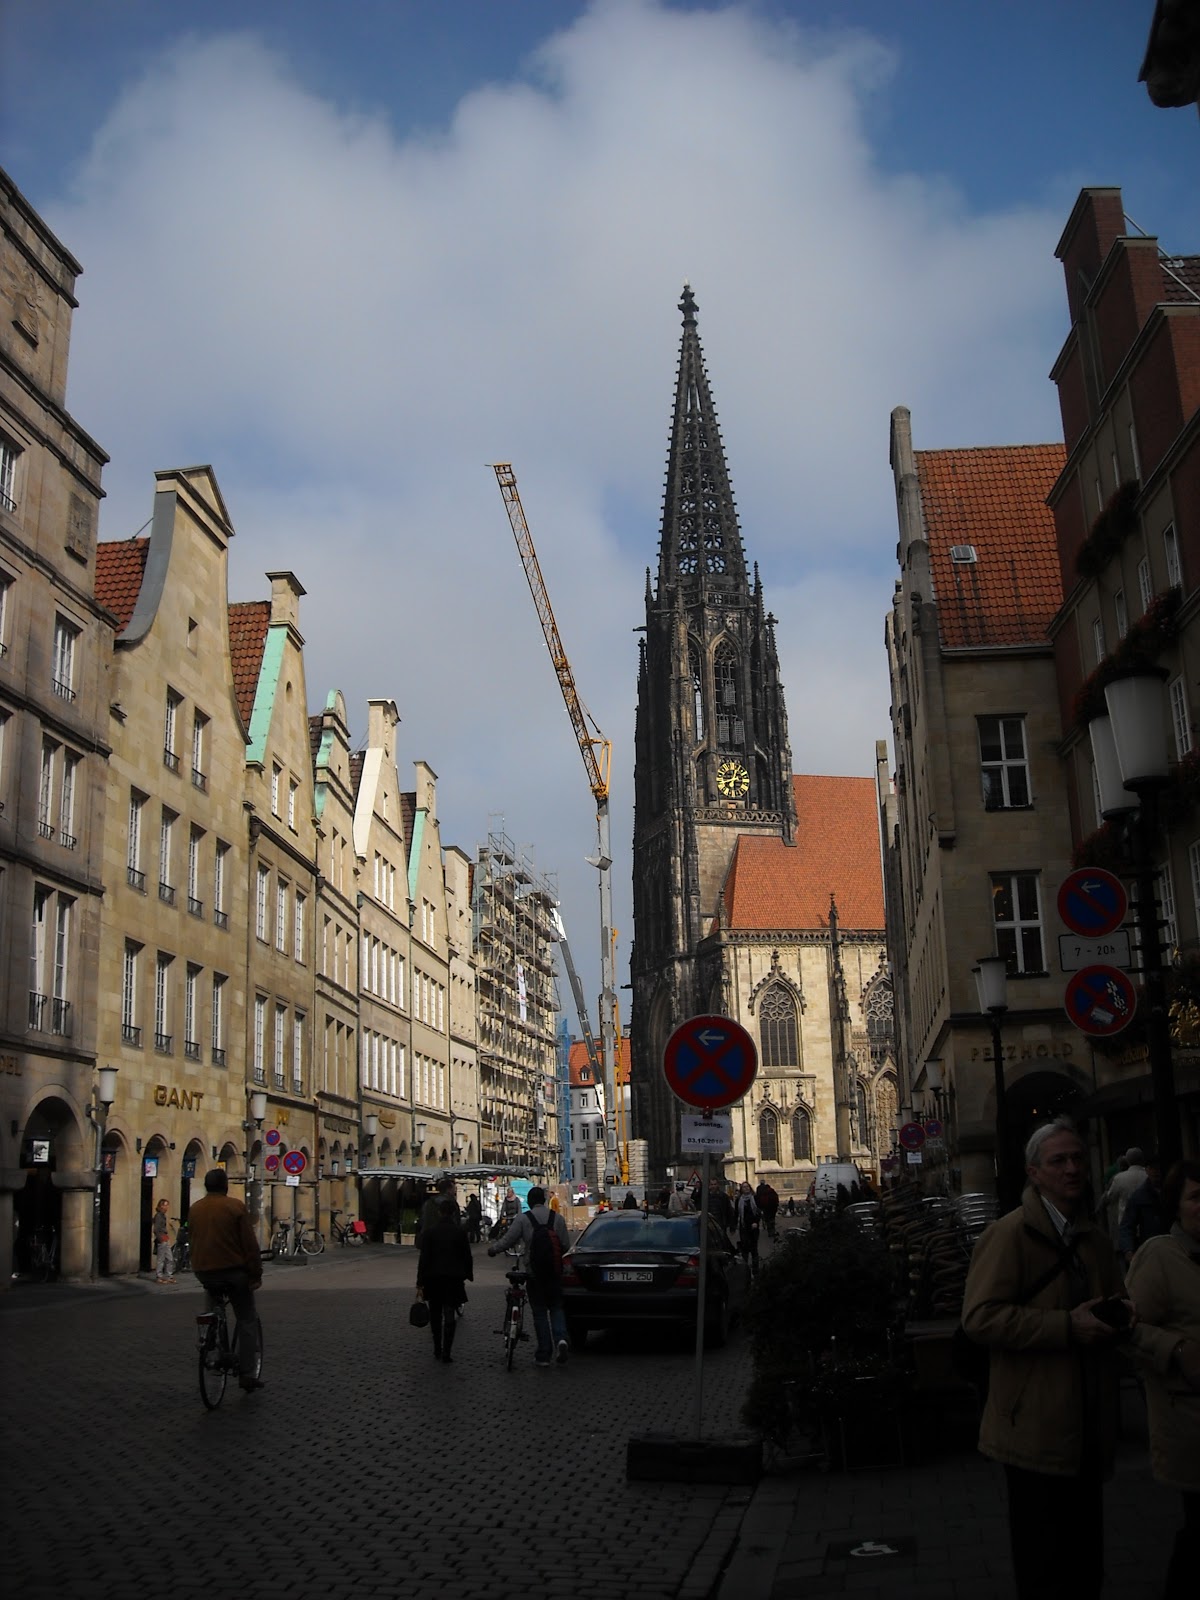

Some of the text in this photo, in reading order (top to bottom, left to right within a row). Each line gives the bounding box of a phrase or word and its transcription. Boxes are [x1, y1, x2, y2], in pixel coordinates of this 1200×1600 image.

[971, 1043, 1073, 1062] PEZHOLD
[154, 1085, 204, 1112] GANT
[636, 1272, 652, 1281] 250
